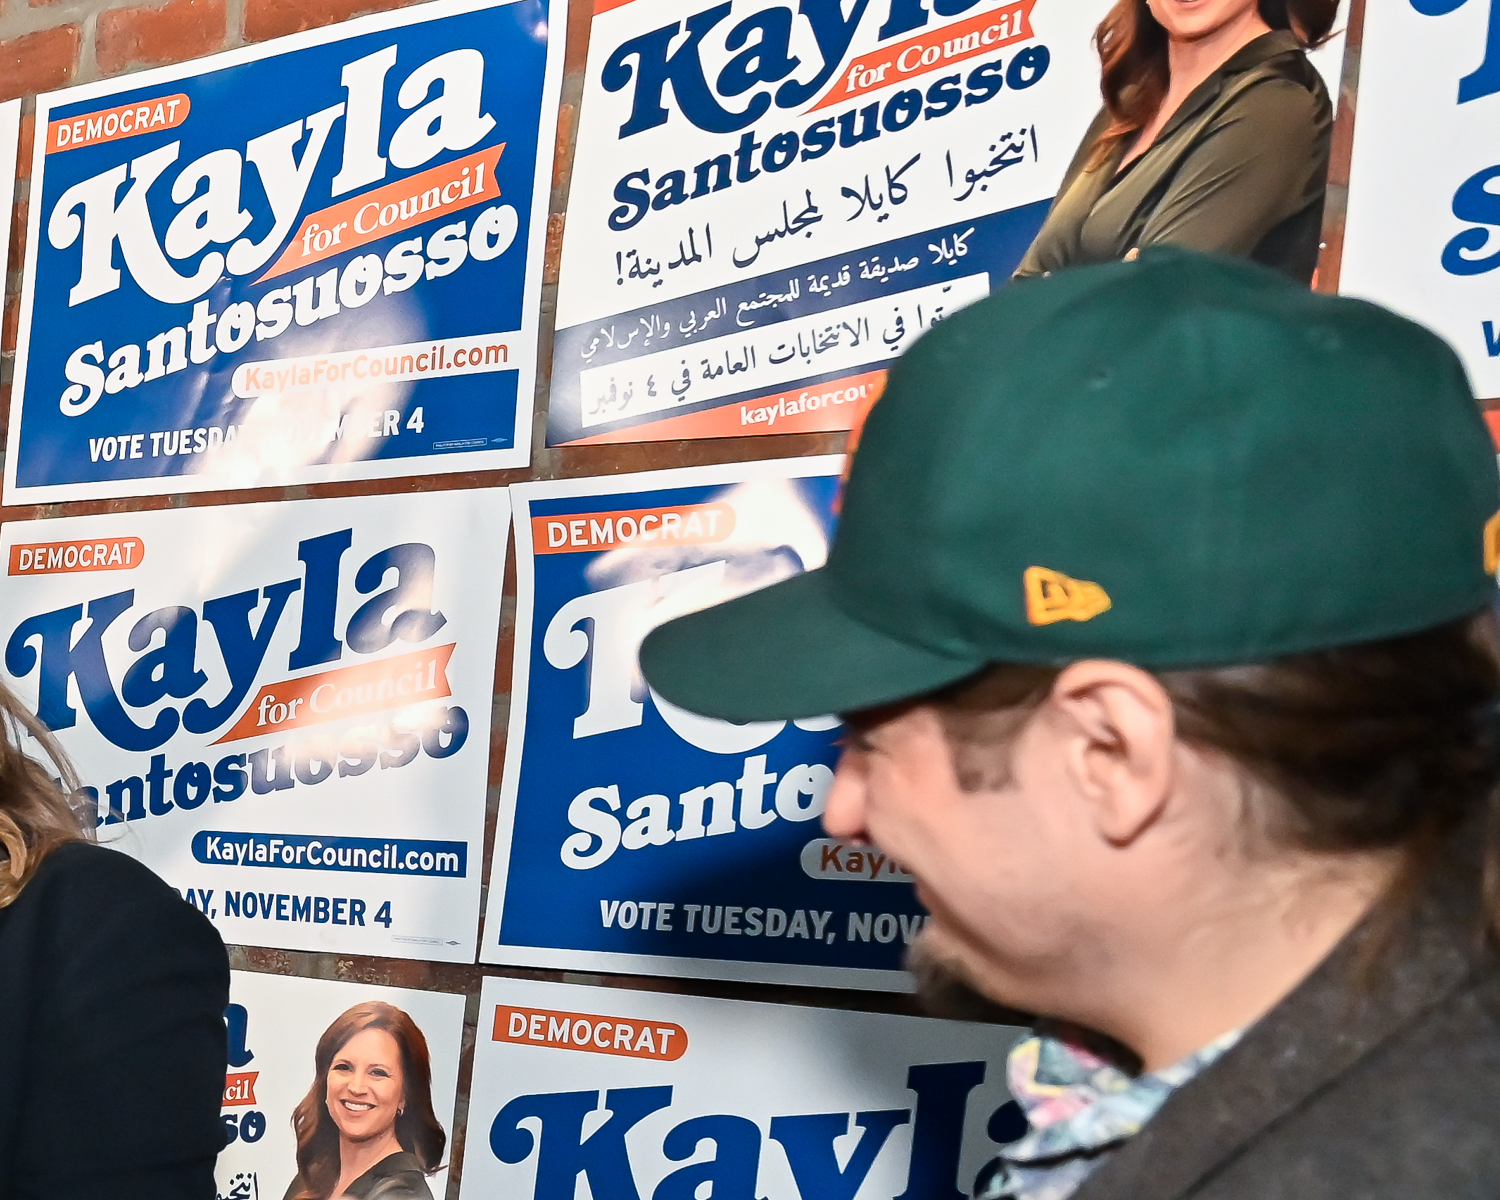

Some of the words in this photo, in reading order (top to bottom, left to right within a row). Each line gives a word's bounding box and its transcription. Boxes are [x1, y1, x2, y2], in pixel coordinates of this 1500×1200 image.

[845, 63, 890, 94] for
[896, 10, 1024, 70] Council
[56, 99, 181, 146] DEMOCRAT
[608, 43, 1051, 232] Santosuosso
[45, 43, 497, 307] Kayla
[841, 153, 920, 225] كايلا
[947, 124, 1039, 203] انتخبوا
[302, 222, 346, 256] for
[354, 161, 485, 236] Council
[732, 187, 823, 269] لمجلس
[615, 223, 713, 288] المدينة!
[859, 256, 919, 283] صديقة
[928, 227, 975, 265] كايلا
[60, 205, 518, 416] Santosuosso
[882, 307, 905, 351] في
[245, 342, 509, 394] KaylaForCouncil.com
[89, 433, 144, 463] VOTE
[149, 424, 237, 457] TUESDA
[406, 406, 425, 434] 4
[19, 543, 136, 571] DEMOCRAT
[547, 509, 723, 549] DEMOCRAT
[5, 528, 447, 752] Kayla
[256, 694, 303, 727] for
[309, 661, 437, 713] Council
[206, 836, 459, 873] KaylaForCouncil.com
[225, 891, 366, 928] NOVEMBER
[374, 901, 393, 929] 4
[600, 900, 675, 932] VOTE
[683, 904, 836, 945] TUESDAY,
[508, 1012, 676, 1056] DEMOCRAT
